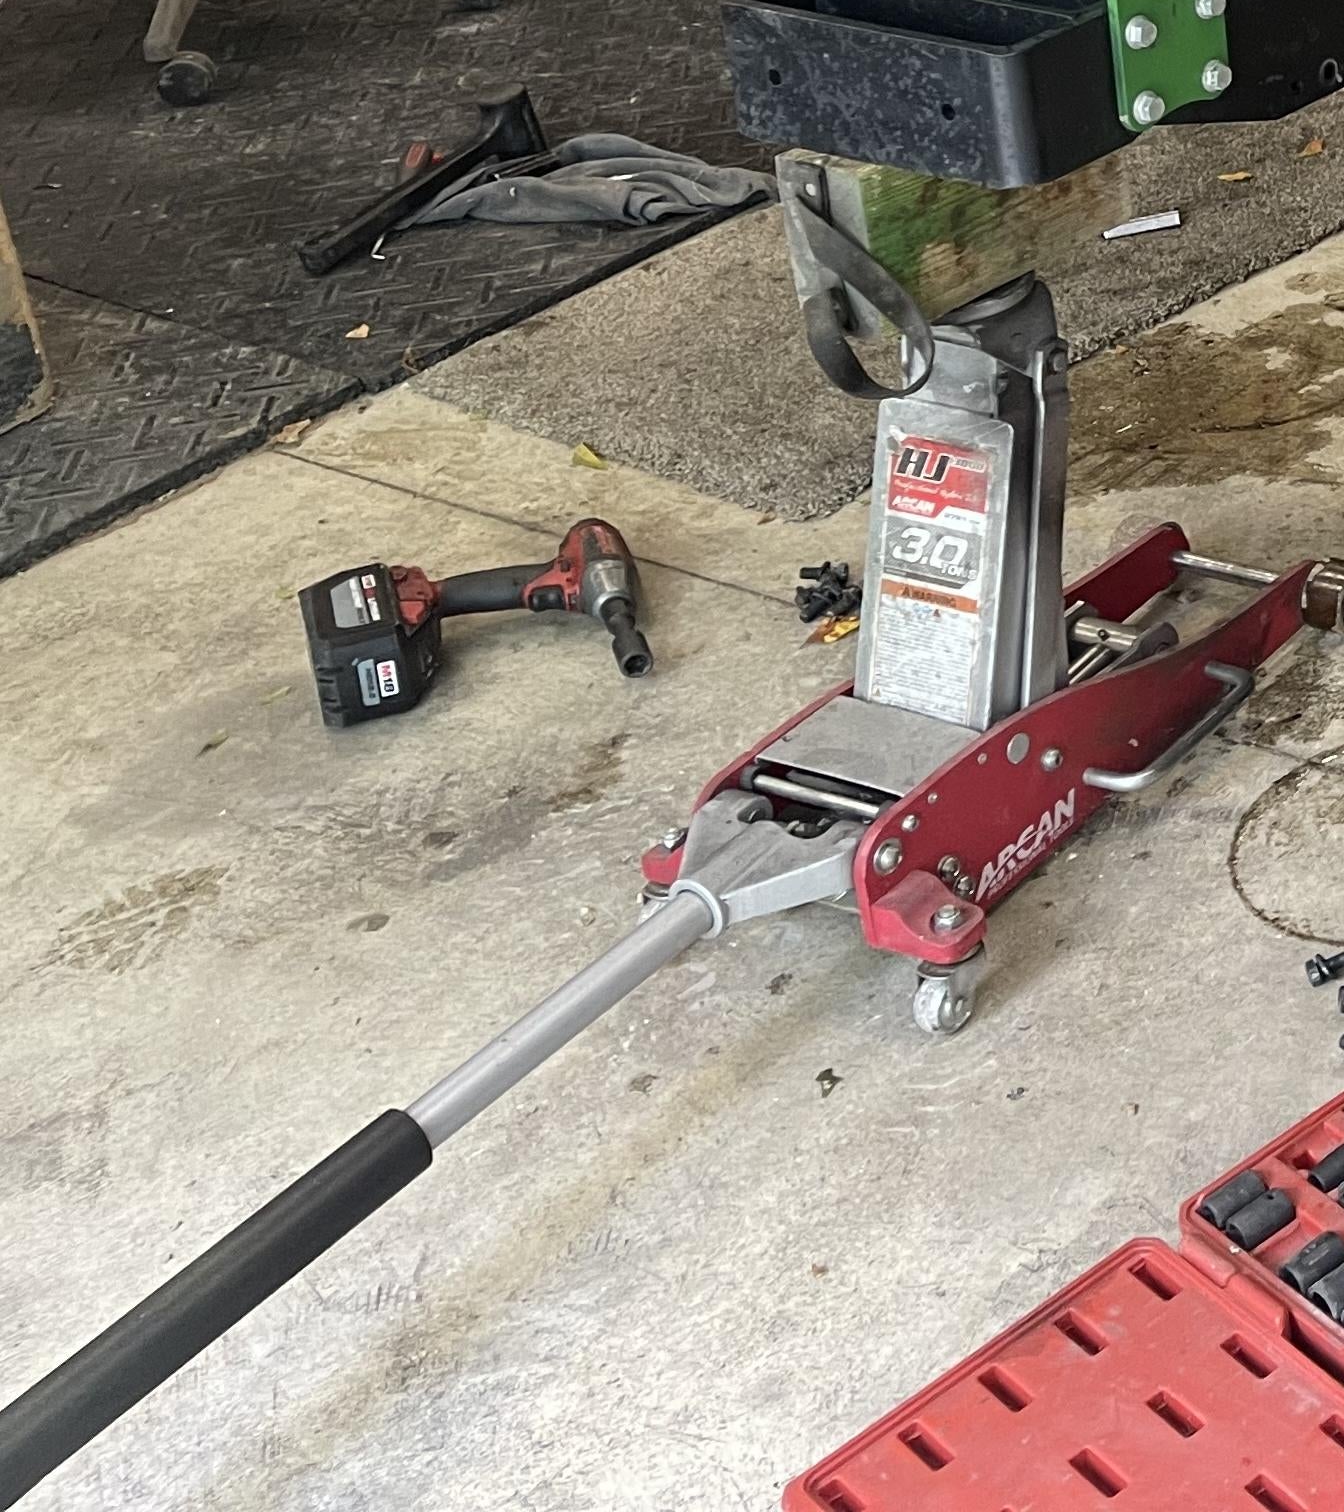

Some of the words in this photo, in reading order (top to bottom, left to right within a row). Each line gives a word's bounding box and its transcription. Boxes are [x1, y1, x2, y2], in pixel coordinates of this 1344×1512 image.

[896, 447, 951, 482] HJ
[892, 527, 969, 569] 3.0
[941, 562, 978, 580] TONS
[381, 664, 395, 693] M18
[975, 787, 1076, 903] ARCAN
